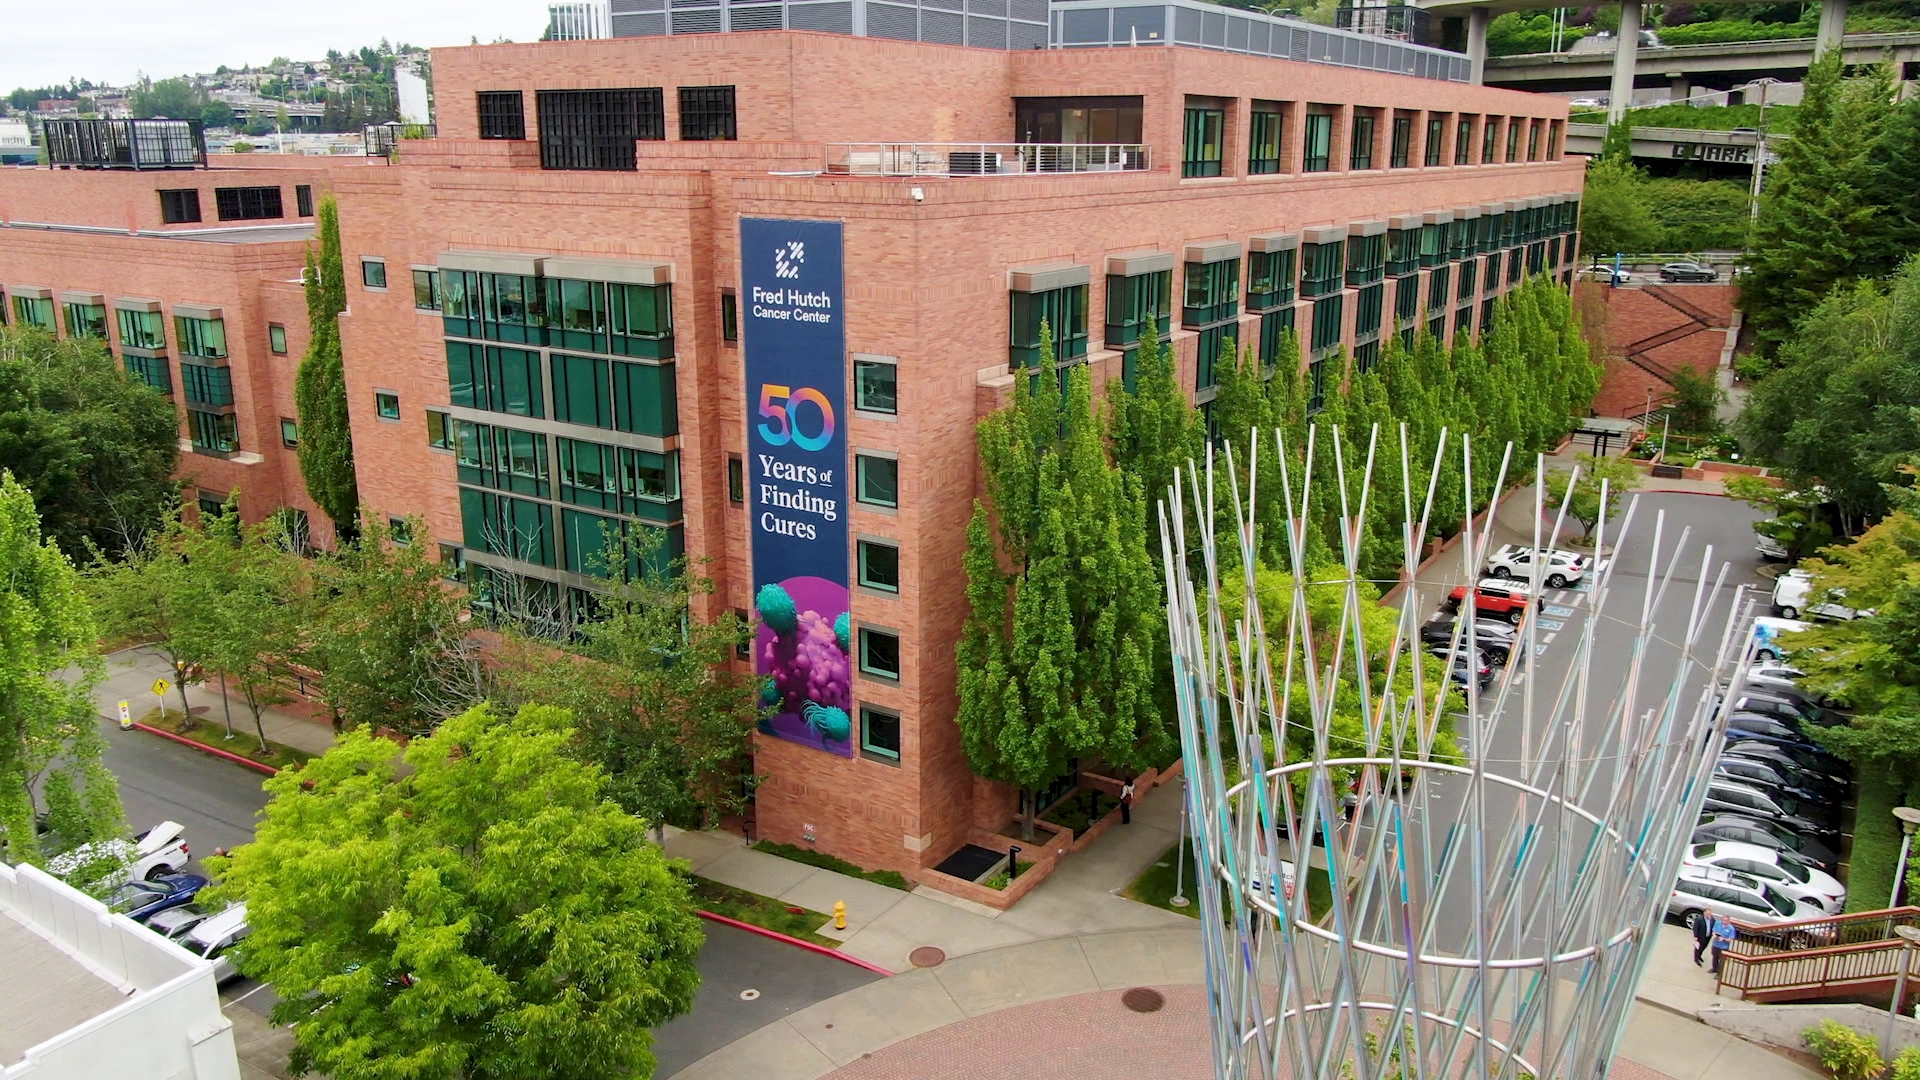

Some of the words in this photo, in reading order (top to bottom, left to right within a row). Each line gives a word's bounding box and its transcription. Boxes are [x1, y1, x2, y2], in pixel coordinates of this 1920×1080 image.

[753, 286, 784, 305] Fred
[787, 289, 831, 308] Hutch
[753, 305, 791, 320] Cancer
[793, 308, 831, 323] Center
[757, 383, 835, 452] 50
[758, 453, 818, 485] Years
[819, 470, 833, 485] of
[759, 483, 837, 522] Finding
[760, 511, 817, 541] Cures
